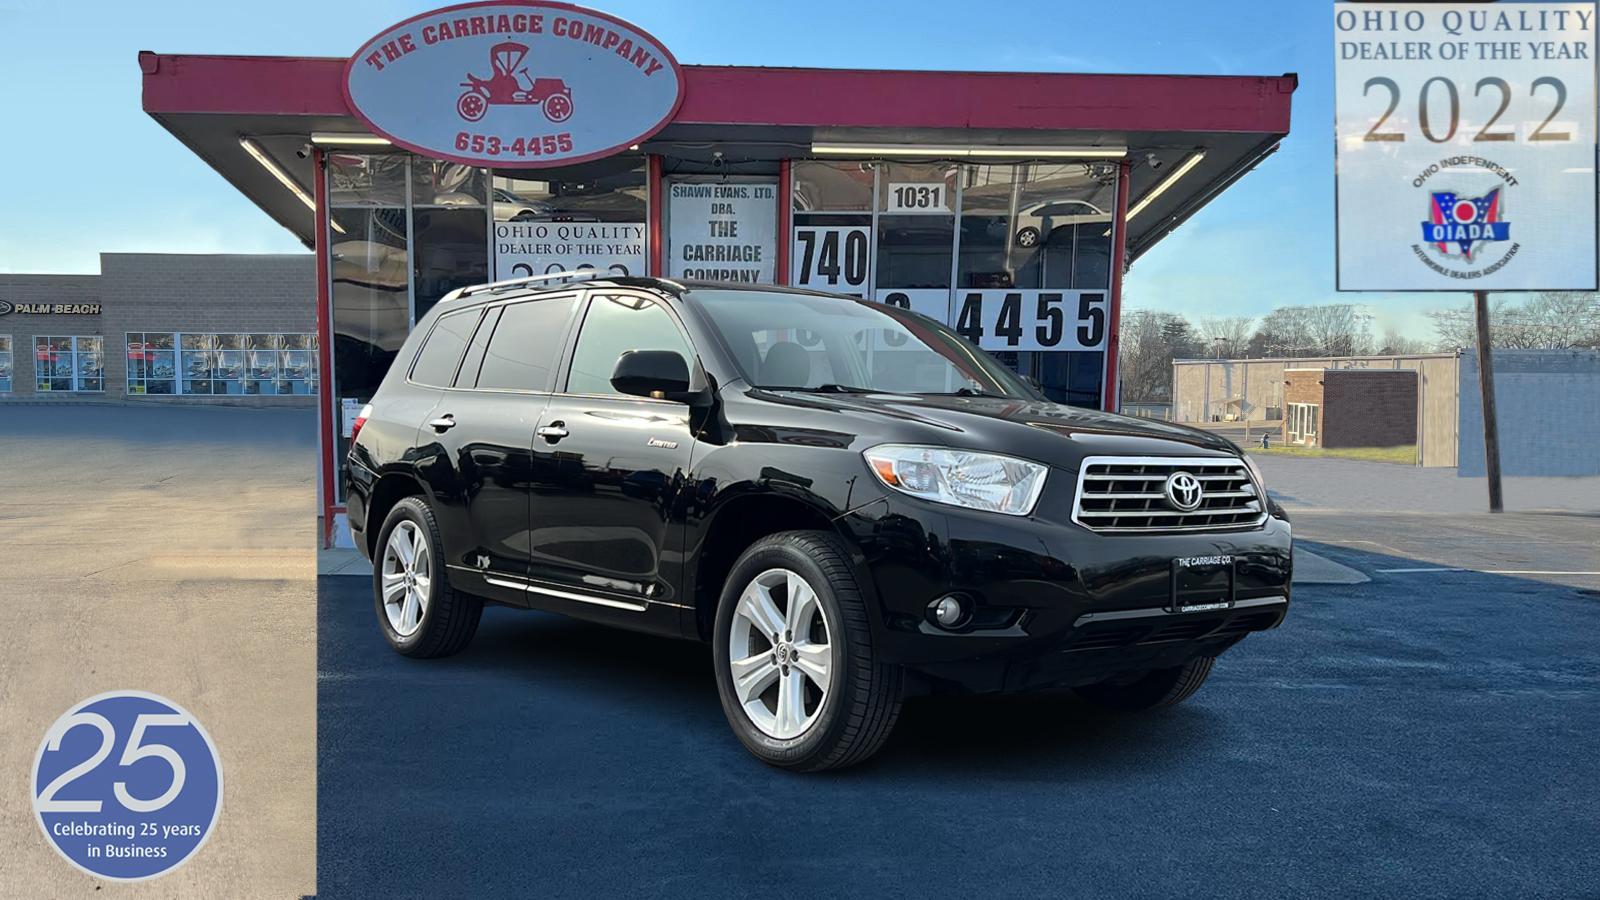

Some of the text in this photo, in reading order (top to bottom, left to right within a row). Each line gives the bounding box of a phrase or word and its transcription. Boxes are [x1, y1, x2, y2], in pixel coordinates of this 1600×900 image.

[1337, 10, 1593, 35] OHIO QUALITY
[366, 14, 664, 77] THE CARRIAGE COMPANY
[1340, 42, 1589, 60] DEALER OF THE YEAR
[1363, 76, 1571, 143] 2022
[455, 131, 573, 156] 653-4455
[1412, 155, 1519, 188] OHIO INDEPENDENT
[673, 186, 711, 198] SHAWN
[754, 187, 775, 199] LTD.
[894, 187, 940, 208] 1031
[711, 203, 736, 214] DBA.
[497, 226, 644, 241] OHIO QUALITY
[708, 220, 738, 238] THE
[1432, 224, 1495, 241] OIADA
[500, 243, 641, 255] DEALER OF THE YEAR
[683, 244, 762, 262] CARRIAGE
[797, 230, 867, 285] 740
[1411, 242, 1520, 279] AUTOMOBILE DEALERS ASSOCIATION
[683, 268, 761, 283] COMPANY
[15, 303, 50, 313] PALM
[957, 293, 1105, 347] 4455
[1179, 558, 1190, 567] THE
[1191, 556, 1221, 566] CARRIAGE
